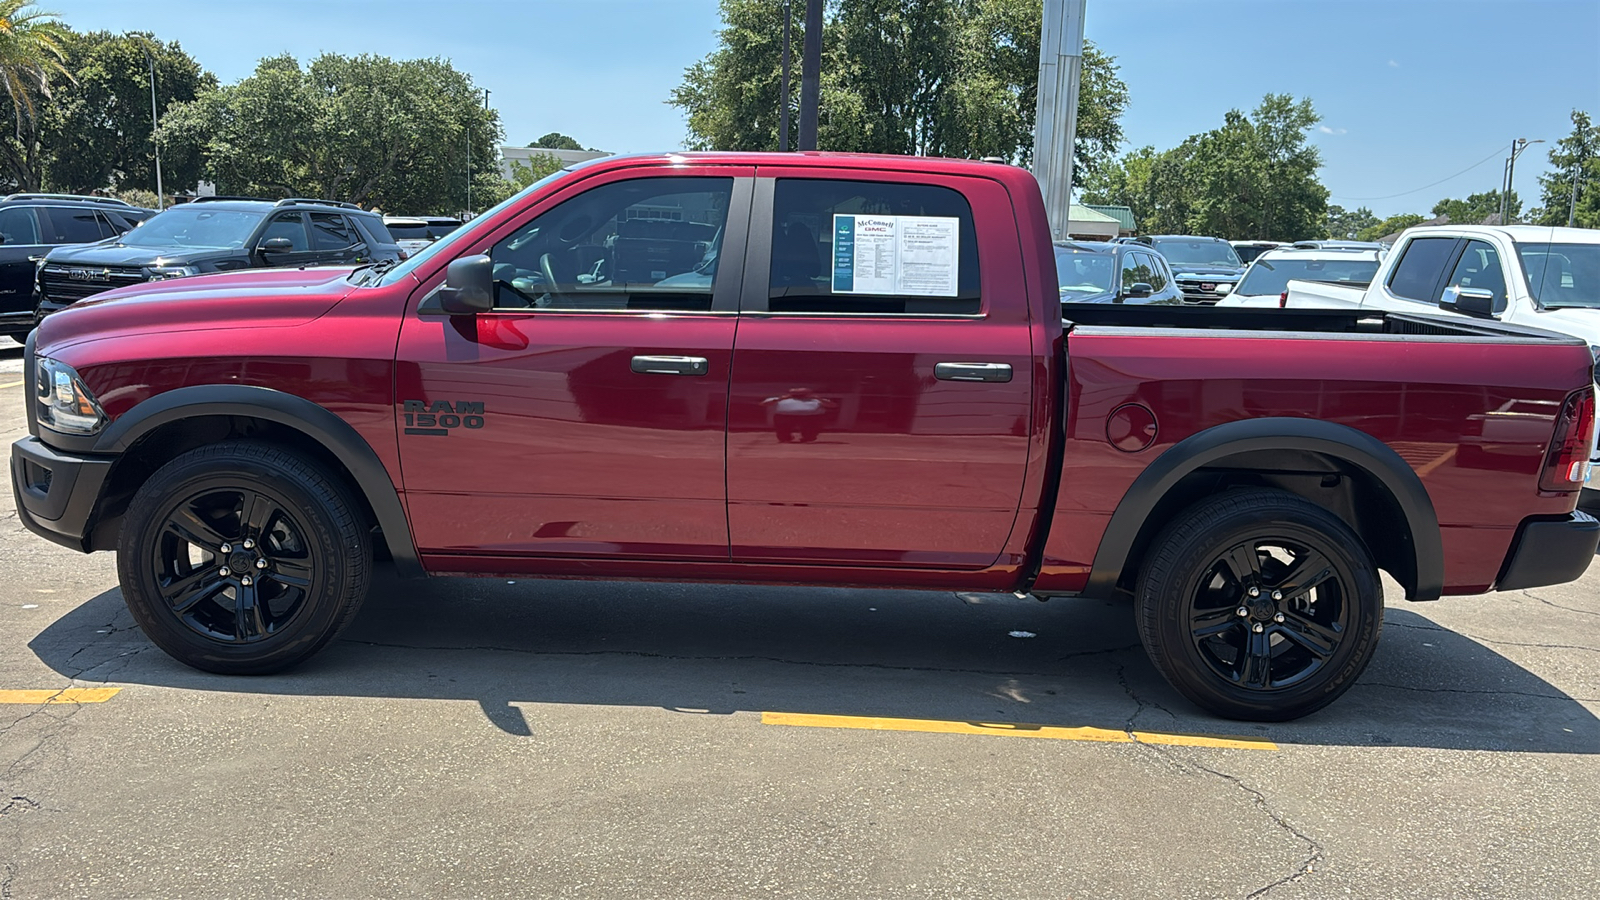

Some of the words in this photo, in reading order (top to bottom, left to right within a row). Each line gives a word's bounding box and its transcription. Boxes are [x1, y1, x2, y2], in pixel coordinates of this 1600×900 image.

[857, 219, 894, 229] McConnell
[403, 399, 484, 414] RAM
[404, 413, 484, 429] 1500
